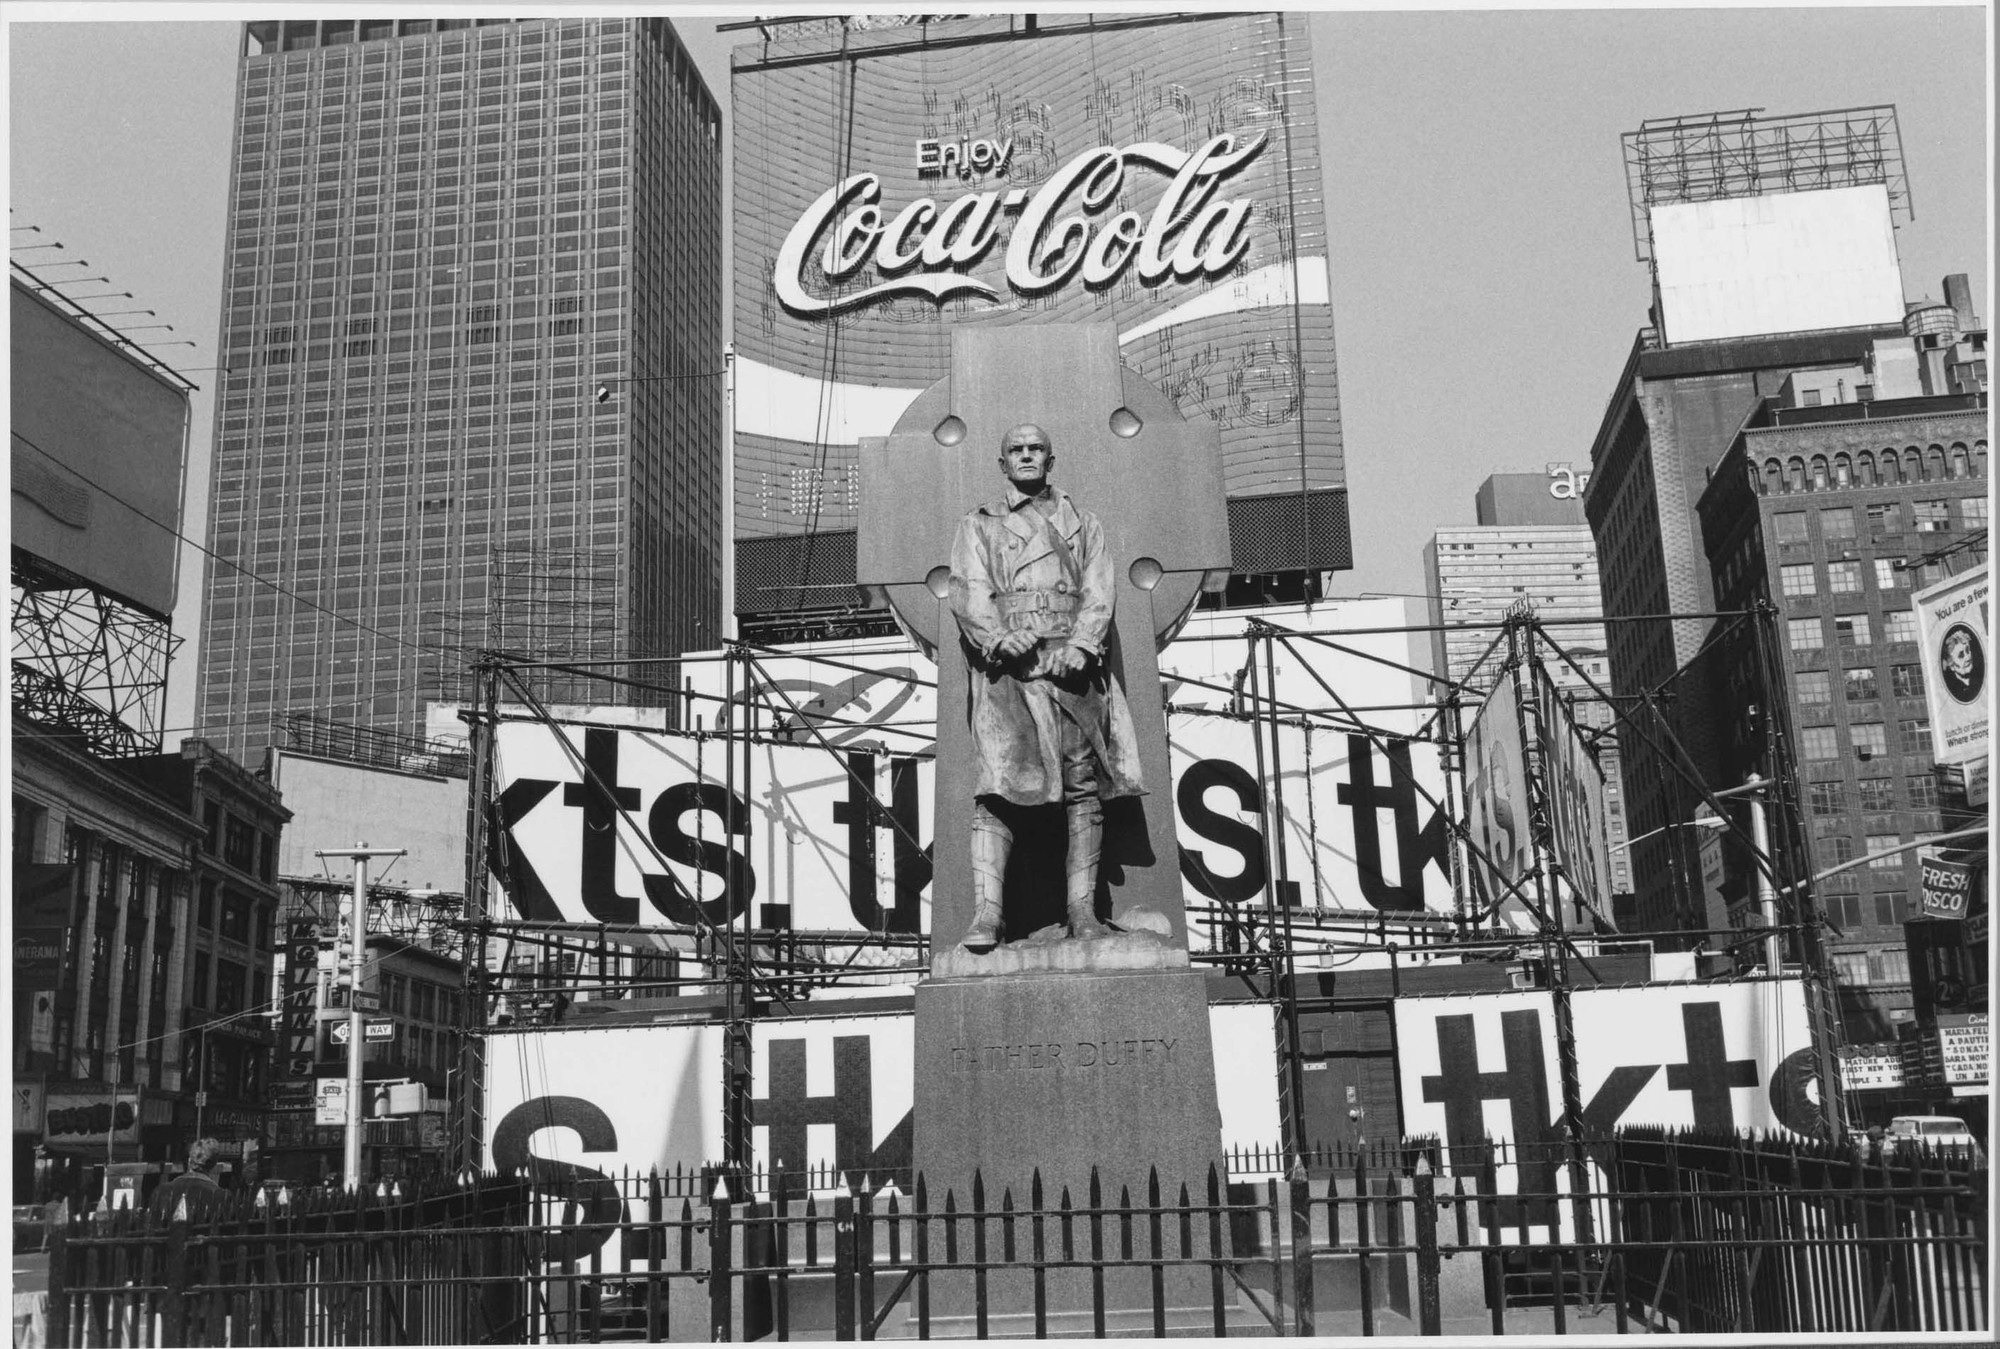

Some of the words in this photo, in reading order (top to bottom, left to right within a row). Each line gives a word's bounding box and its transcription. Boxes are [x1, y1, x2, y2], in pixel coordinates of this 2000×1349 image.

[916, 134, 1013, 179] Enjoy
[775, 130, 1269, 318] Coca-Cola
[1935, 606, 1952, 621] You
[1952, 599, 1966, 613] are
[1967, 594, 1974, 604] a
[1922, 865, 1971, 890] FRESH
[1922, 887, 1963, 911] DISCO
[370, 1025, 389, 1035] WAY
[1944, 1028, 1970, 1036] MARIA
[951, 1043, 1065, 1072] FATHER
[1077, 1039, 1177, 1067] DUFFY
[1846, 1058, 1878, 1066] MATURE
[1945, 1055, 1966, 1063] SARA
